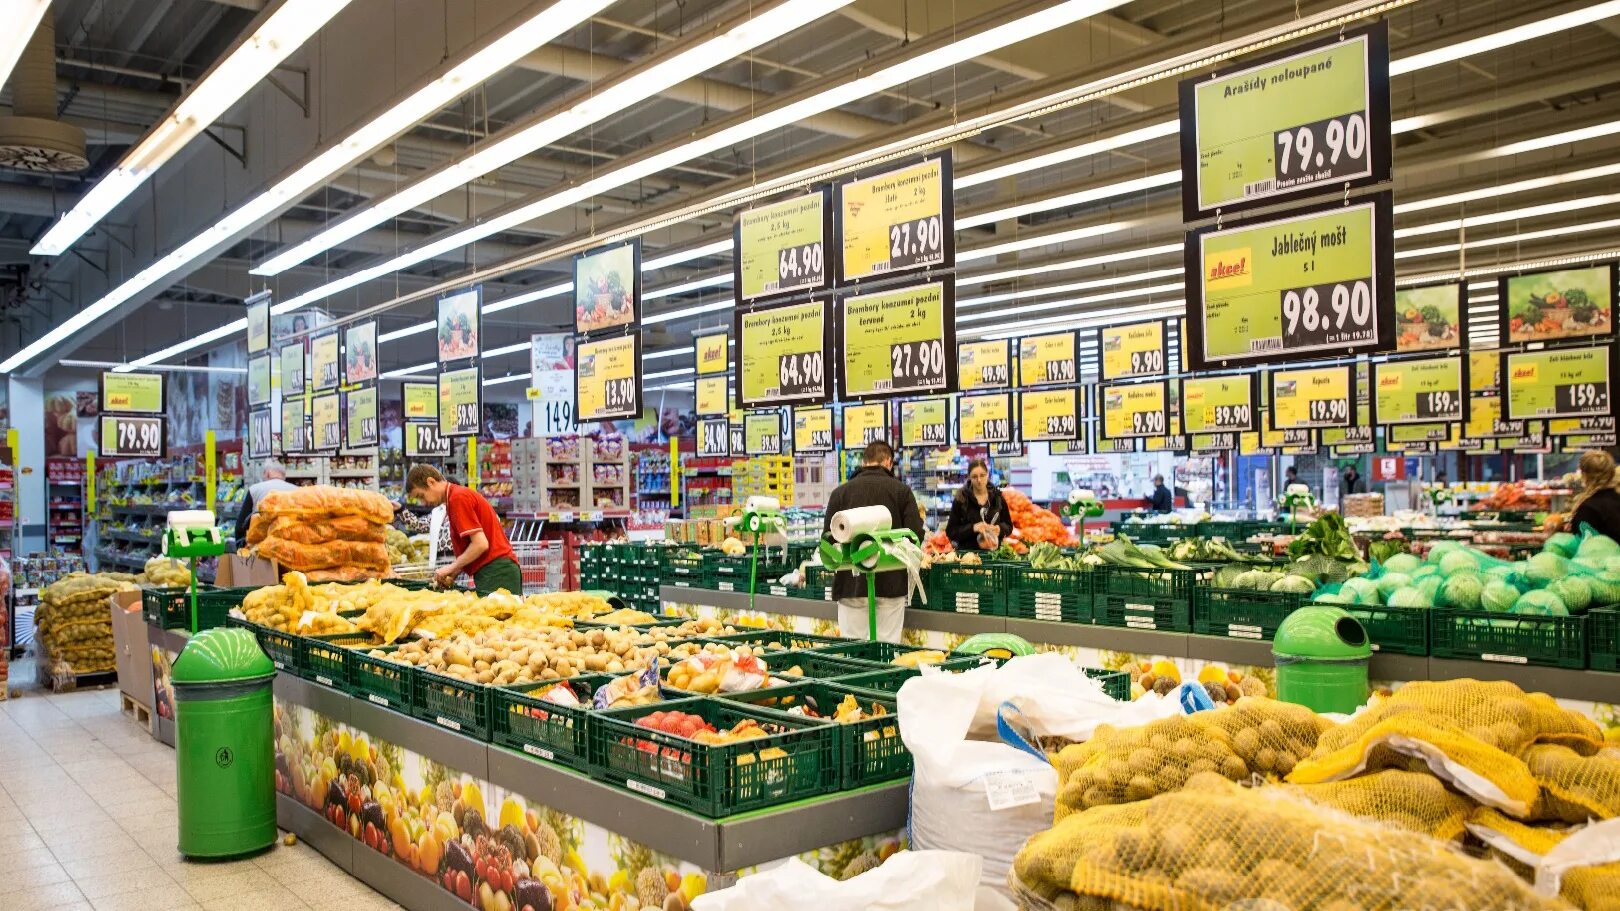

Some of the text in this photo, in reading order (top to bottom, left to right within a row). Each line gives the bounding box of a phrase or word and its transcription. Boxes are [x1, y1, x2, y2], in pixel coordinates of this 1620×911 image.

[1223, 76, 1267, 98] Arašídy
[1277, 113, 1366, 174] 79.90
[782, 219, 790, 230] kg
[890, 216, 941, 259] 27.90
[1271, 225, 1347, 257] Jablečný mošt
[779, 243, 822, 280] 64.90
[1209, 257, 1247, 278] akce!
[847, 303, 880, 315] Brambory
[915, 291, 940, 307] pozdní
[910, 308, 927, 320] 2 kg
[1283, 280, 1371, 336] 98.90
[744, 317, 771, 329] Brambory
[783, 325, 791, 336] kg
[780, 351, 822, 387] 64.90
[891, 339, 944, 379] 27.90
[1047, 359, 1073, 381] 19.90
[1131, 350, 1161, 374] 9.90
[982, 364, 1006, 382] 49.90
[605, 377, 634, 406] 13.90
[1427, 391, 1459, 413] 159.-
[1568, 383, 1607, 407] 159.-
[1215, 404, 1249, 425] 39.90
[1310, 398, 1347, 420] 19.90
[922, 423, 944, 440] 19.90
[983, 418, 1008, 439] 19.90
[1047, 415, 1074, 433] 29.90
[1133, 411, 1163, 434] 9.90
[118, 422, 159, 450] 79.90
[704, 423, 726, 453] 34.90
[731, 431, 744, 452] 98.
